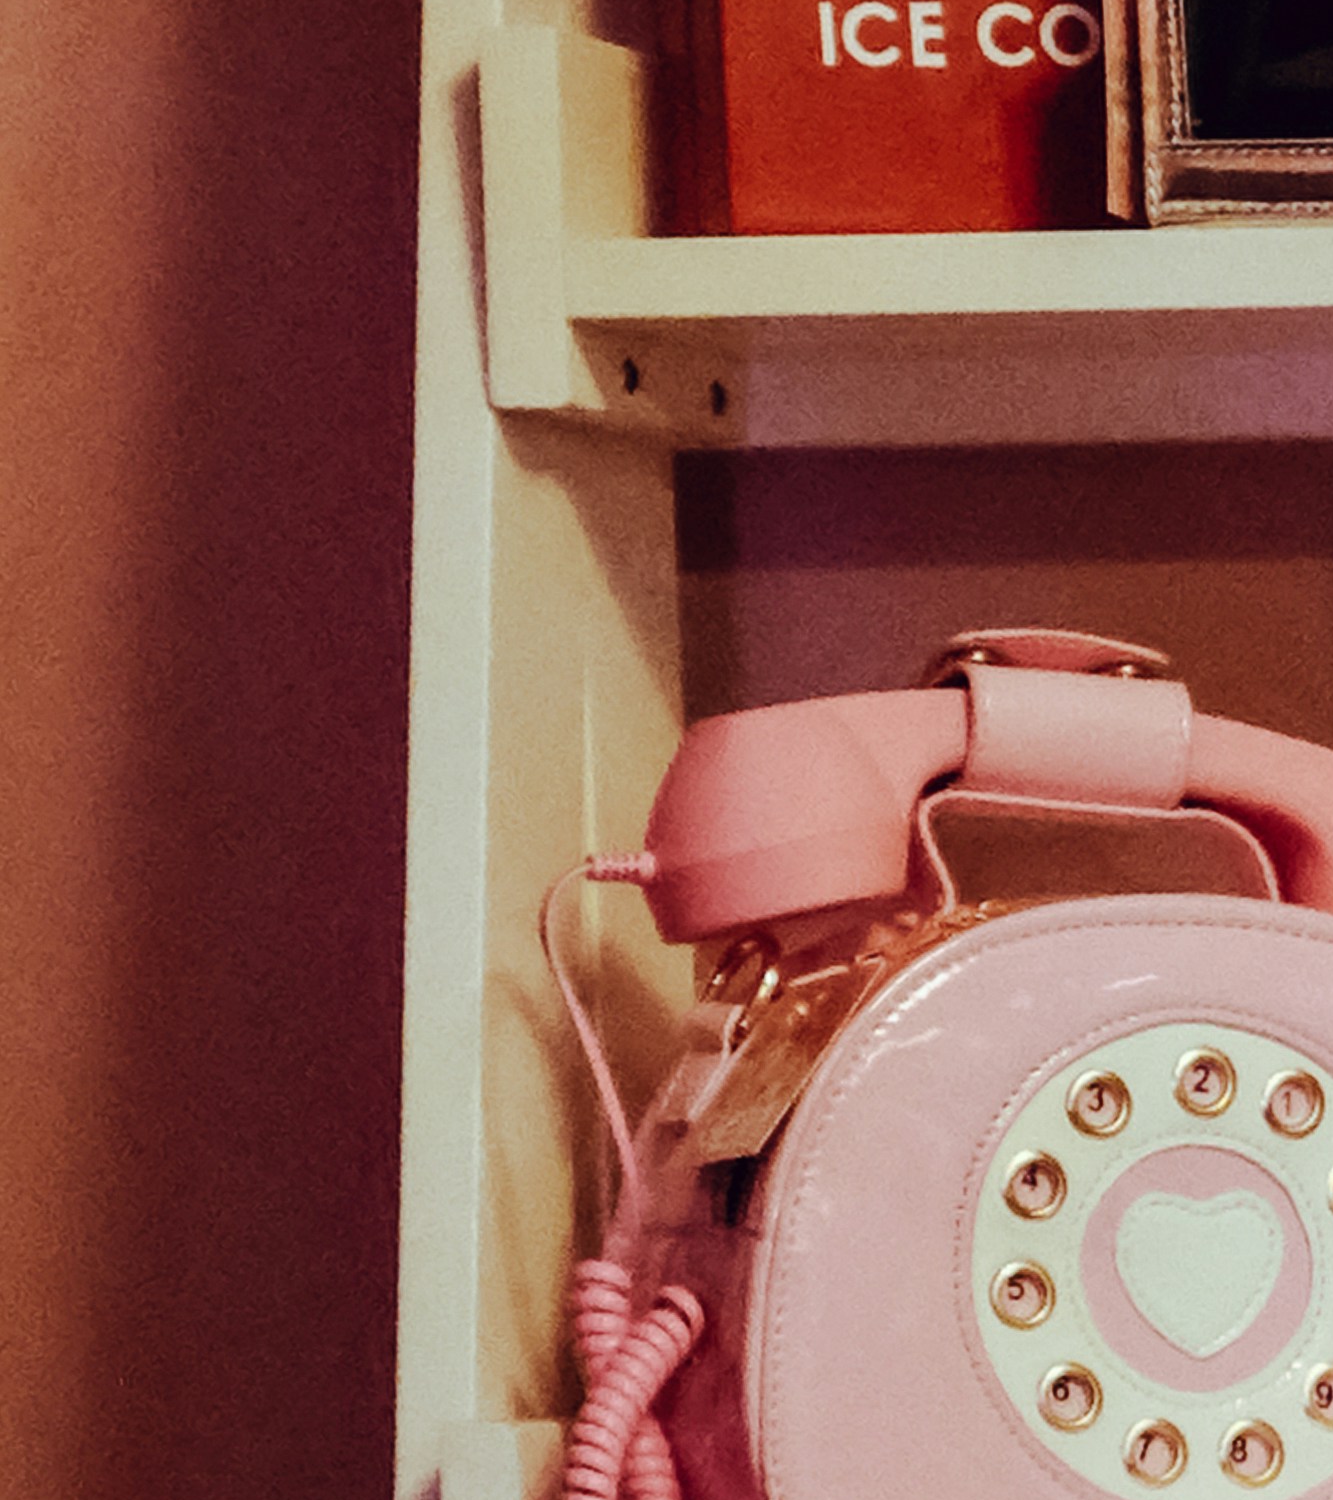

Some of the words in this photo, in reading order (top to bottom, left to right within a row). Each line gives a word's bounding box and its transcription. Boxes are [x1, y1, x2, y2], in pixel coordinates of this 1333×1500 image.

[818, 1, 947, 68] ICE
[976, 3, 1101, 67] CO
[1194, 1066, 1210, 1093] 2
[1089, 1084, 1105, 1112] 3
[1283, 1091, 1292, 1117] 1
[1022, 1162, 1038, 1191] 4
[1007, 1277, 1024, 1300] 5
[1052, 1376, 1069, 1401] 6
[1316, 1381, 1333, 1409] 9
[1138, 1433, 1153, 1461] 7
[1230, 1435, 1248, 1463] 8
